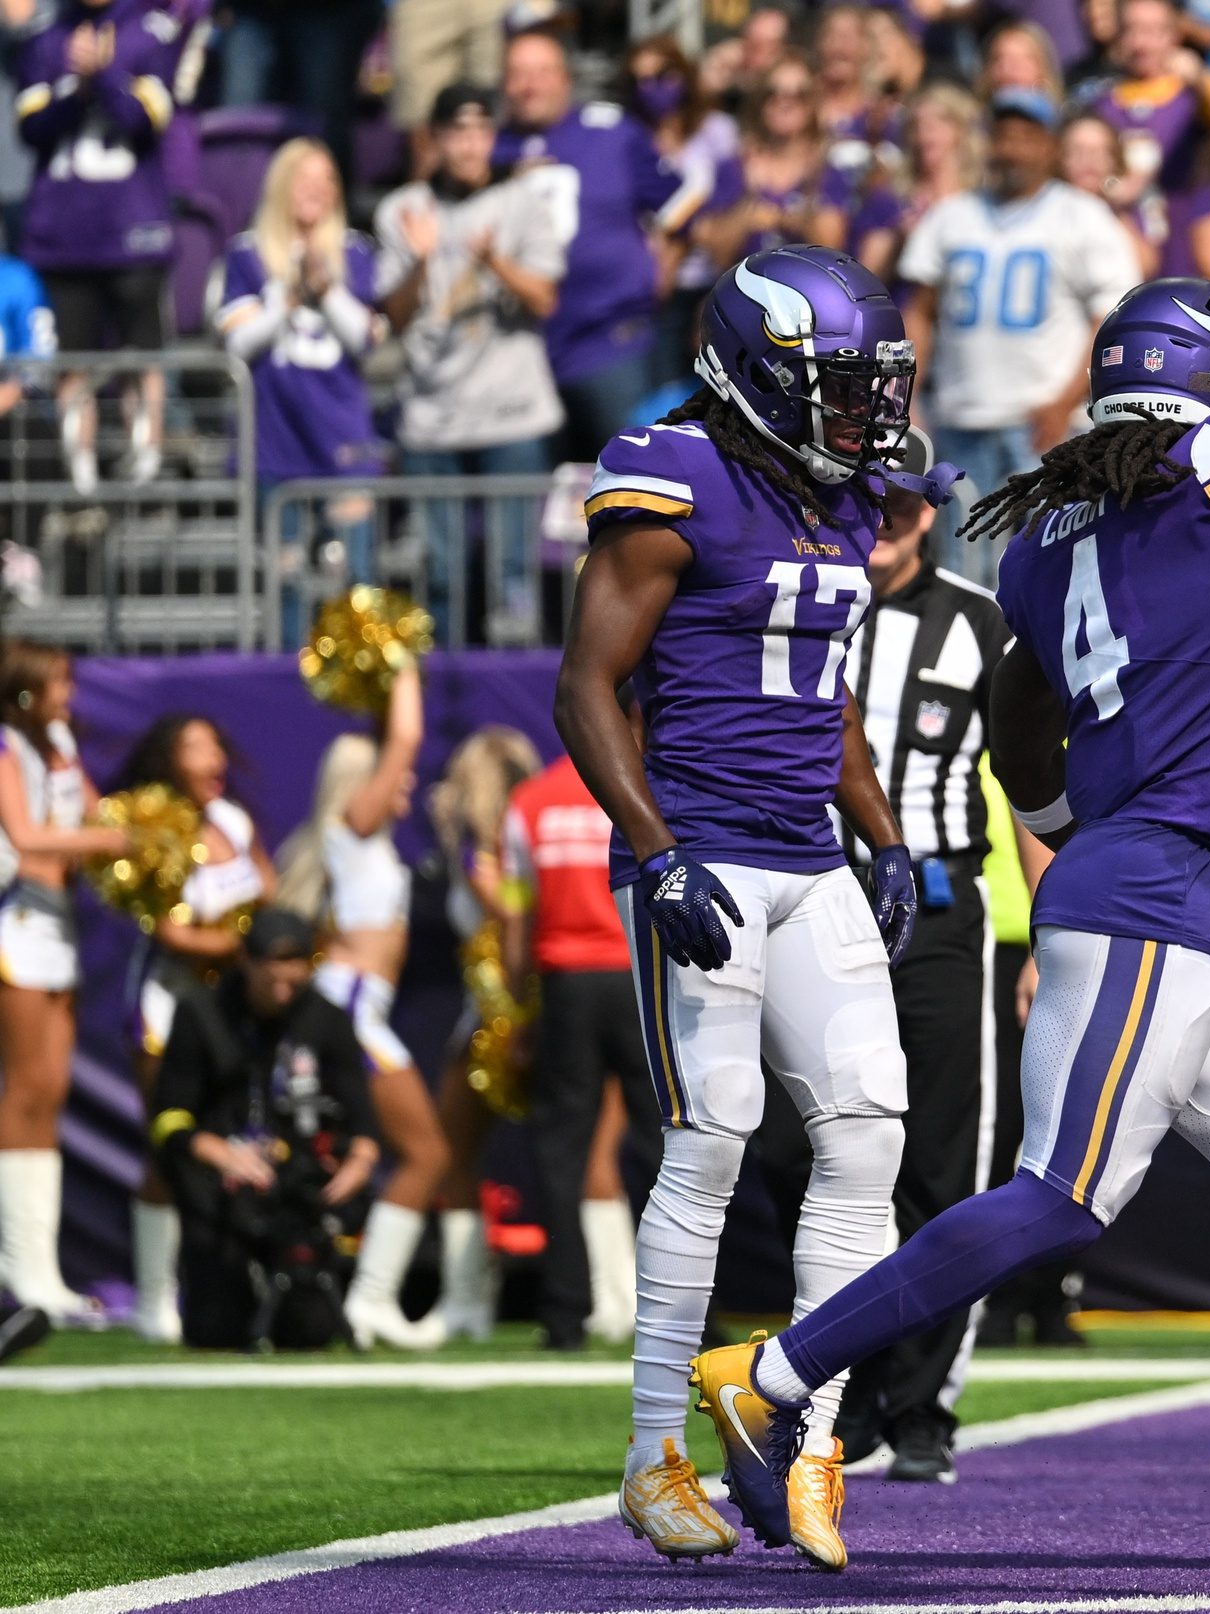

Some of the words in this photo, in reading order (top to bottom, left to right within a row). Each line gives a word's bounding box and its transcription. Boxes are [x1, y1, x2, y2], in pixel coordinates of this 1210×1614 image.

[1148, 401, 1182, 415] LOVE
[761, 560, 872, 700] 17
[1062, 533, 1131, 721] 4
[653, 865, 687, 902] adidas
